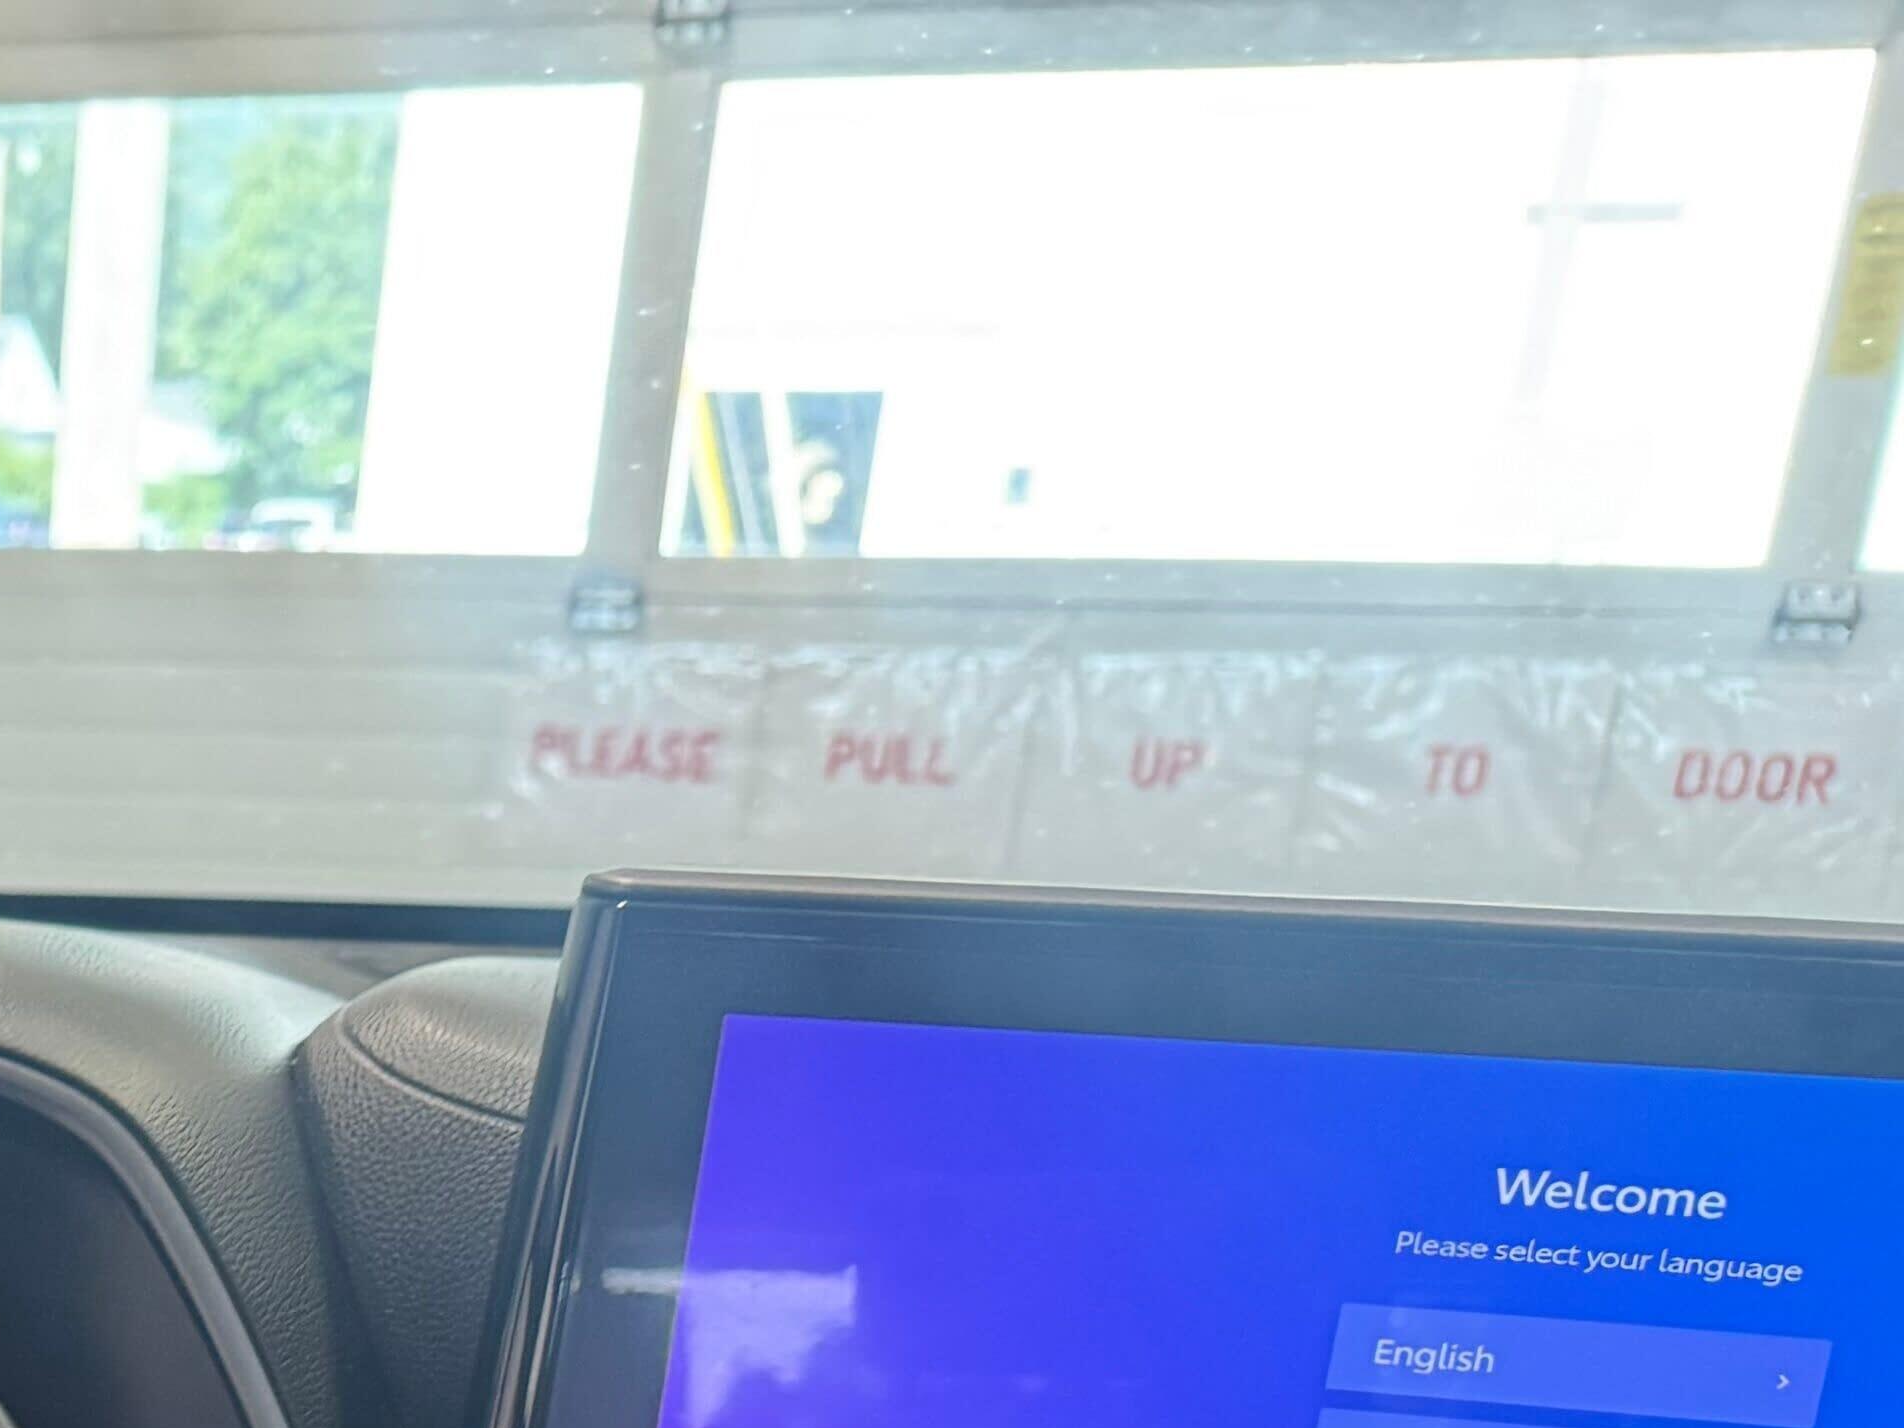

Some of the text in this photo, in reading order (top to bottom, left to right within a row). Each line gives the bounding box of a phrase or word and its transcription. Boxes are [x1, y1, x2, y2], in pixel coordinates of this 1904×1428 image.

[531, 722, 1836, 806] PLEASE PULL UP TO DOOR
[1496, 1167, 1728, 1220] Welcome
[1395, 1231, 1804, 1286] Please select your language
[1373, 1339, 1495, 1374] English
